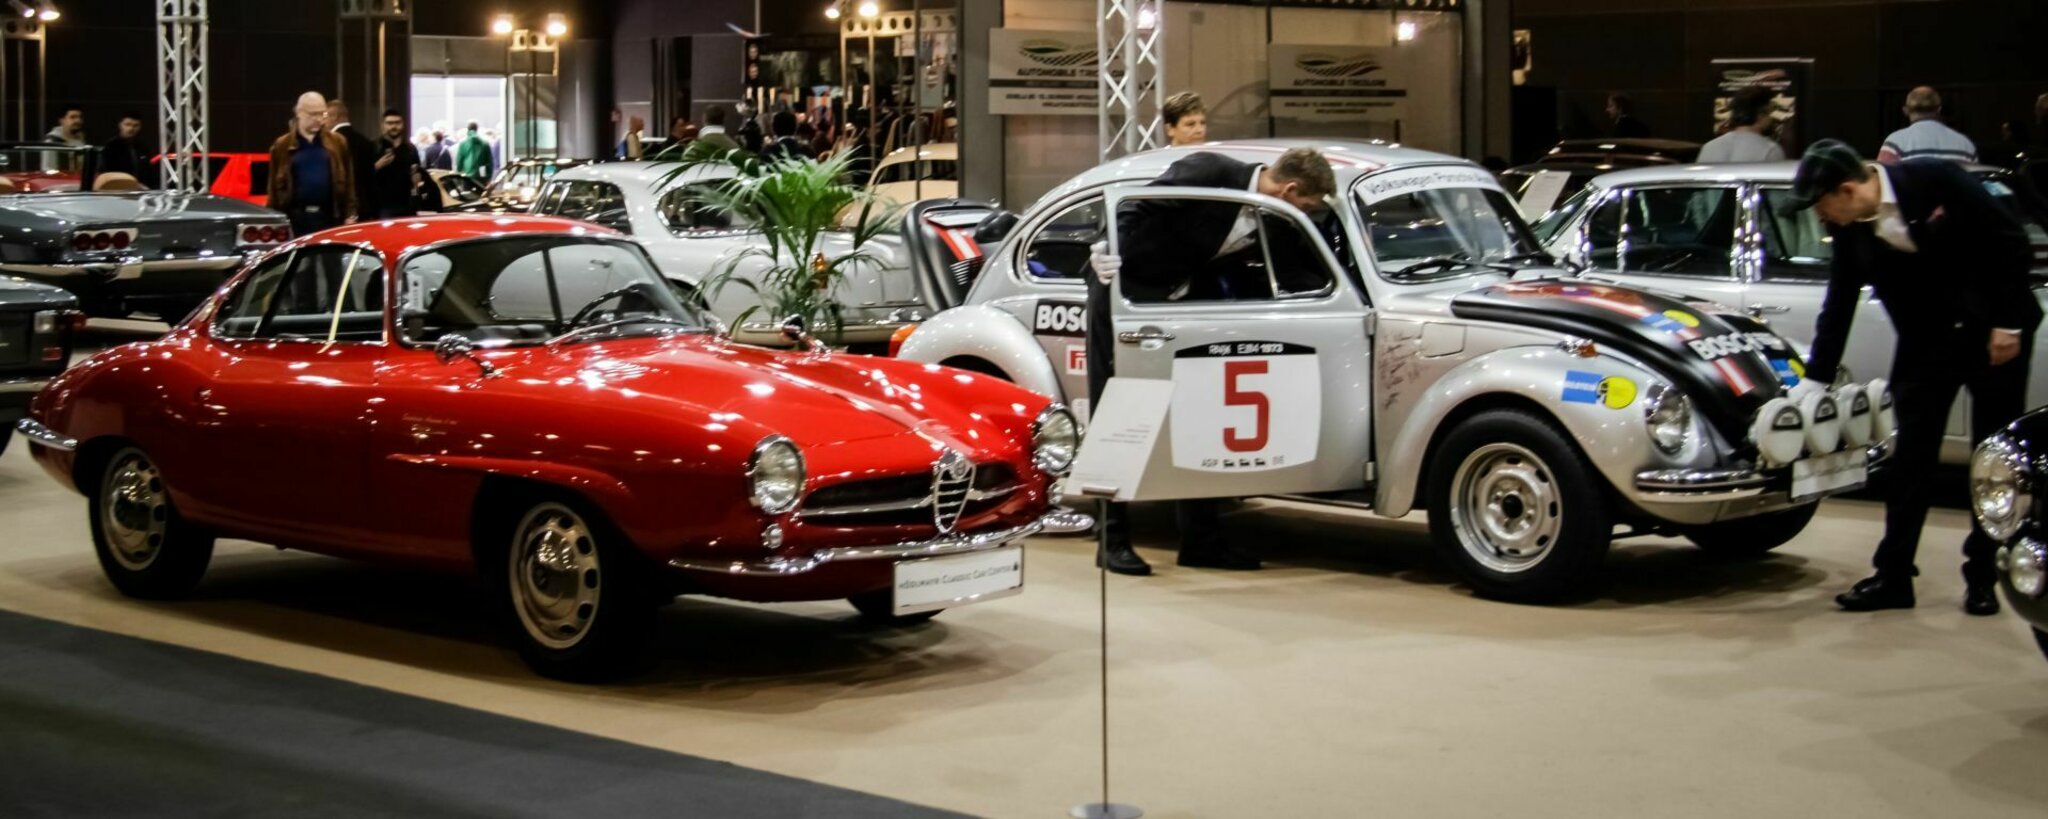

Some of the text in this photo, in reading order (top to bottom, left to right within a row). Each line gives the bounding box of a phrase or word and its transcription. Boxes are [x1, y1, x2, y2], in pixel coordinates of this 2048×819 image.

[1016, 68, 1076, 77] AUTOMOBILE
[1259, 342, 1284, 353] 1973
[1223, 360, 1270, 453] 5
